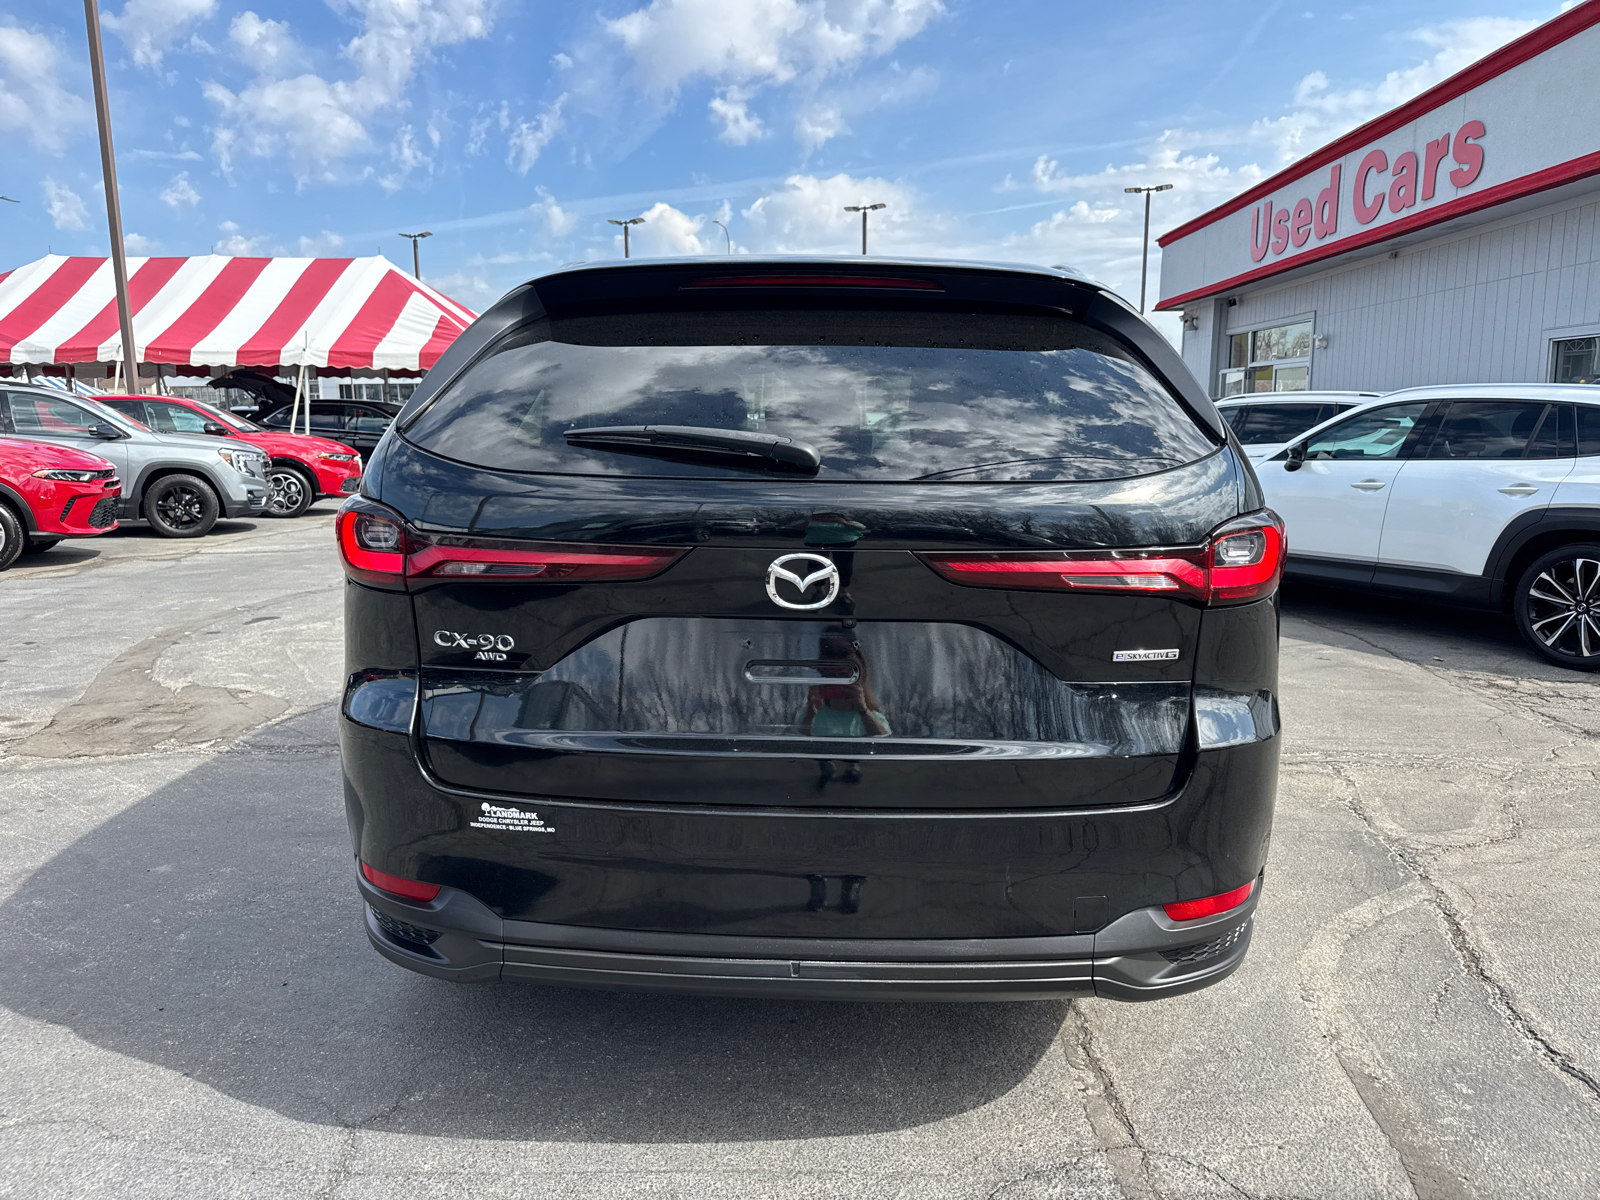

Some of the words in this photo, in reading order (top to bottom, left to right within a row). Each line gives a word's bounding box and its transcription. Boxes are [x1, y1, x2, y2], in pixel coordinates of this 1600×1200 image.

[1250, 163, 1342, 262] Used
[1353, 120, 1486, 225] Cars
[433, 630, 515, 651] CX-90
[474, 651, 507, 661] AWD
[490, 809, 538, 820] LANDMARK
